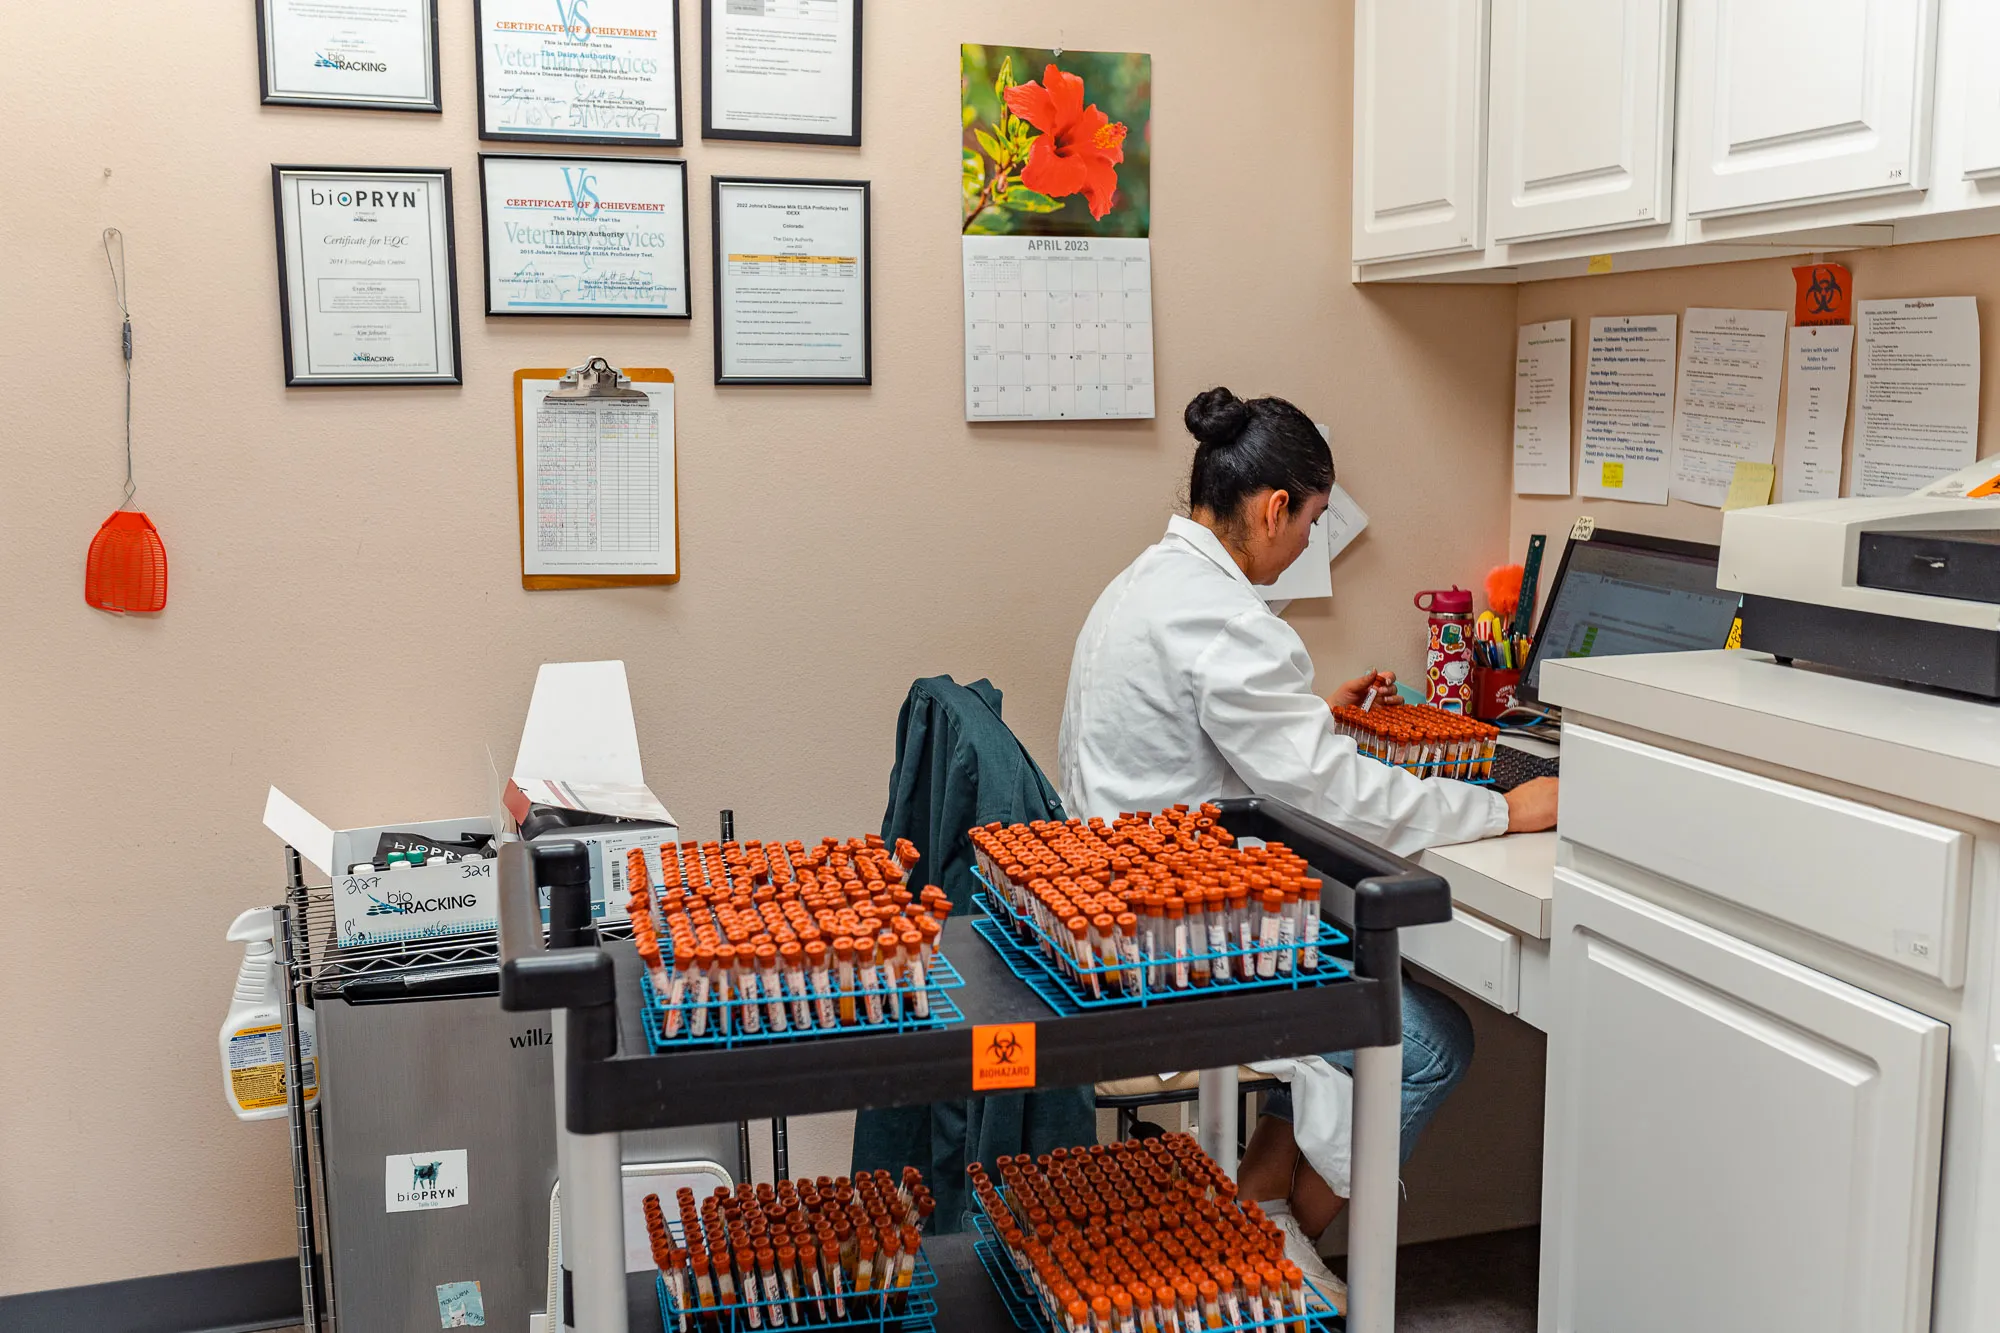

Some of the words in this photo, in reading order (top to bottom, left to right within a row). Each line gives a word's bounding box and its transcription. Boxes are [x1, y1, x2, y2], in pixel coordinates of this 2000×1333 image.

[496, 21, 564, 33] CERTIFICATE
[568, 25, 582, 33] OF
[585, 27, 658, 38] ACHIEVEMENT
[328, 52, 346, 62] bio
[494, 43, 584, 73] Veterinary
[592, 49, 658, 75] Services
[541, 50, 554, 58] The
[557, 51, 577, 60] Dairy
[579, 52, 616, 61] Authority
[334, 60, 387, 73] TRACKING
[311, 189, 417, 208] bioPRYN
[561, 167, 599, 222] VS
[506, 199, 574, 209] CERTIFICATE
[594, 202, 665, 212] ACHIEVEMENT
[504, 222, 594, 248] Veterinary
[598, 225, 665, 248] Services
[567, 230, 587, 238] Dairy
[589, 230, 625, 238] Authority
[323, 235, 367, 247] Certificate
[368, 235, 382, 247] for
[1028, 240, 1062, 251] APRIL
[1064, 240, 1089, 251] 2023
[394, 842, 462, 860] bioPR
[387, 891, 413, 904] bio
[397, 894, 477, 915] TRACKING
[980, 1066, 1030, 1079] BIOHAZARD
[397, 1188, 455, 1202] bioPRYN
